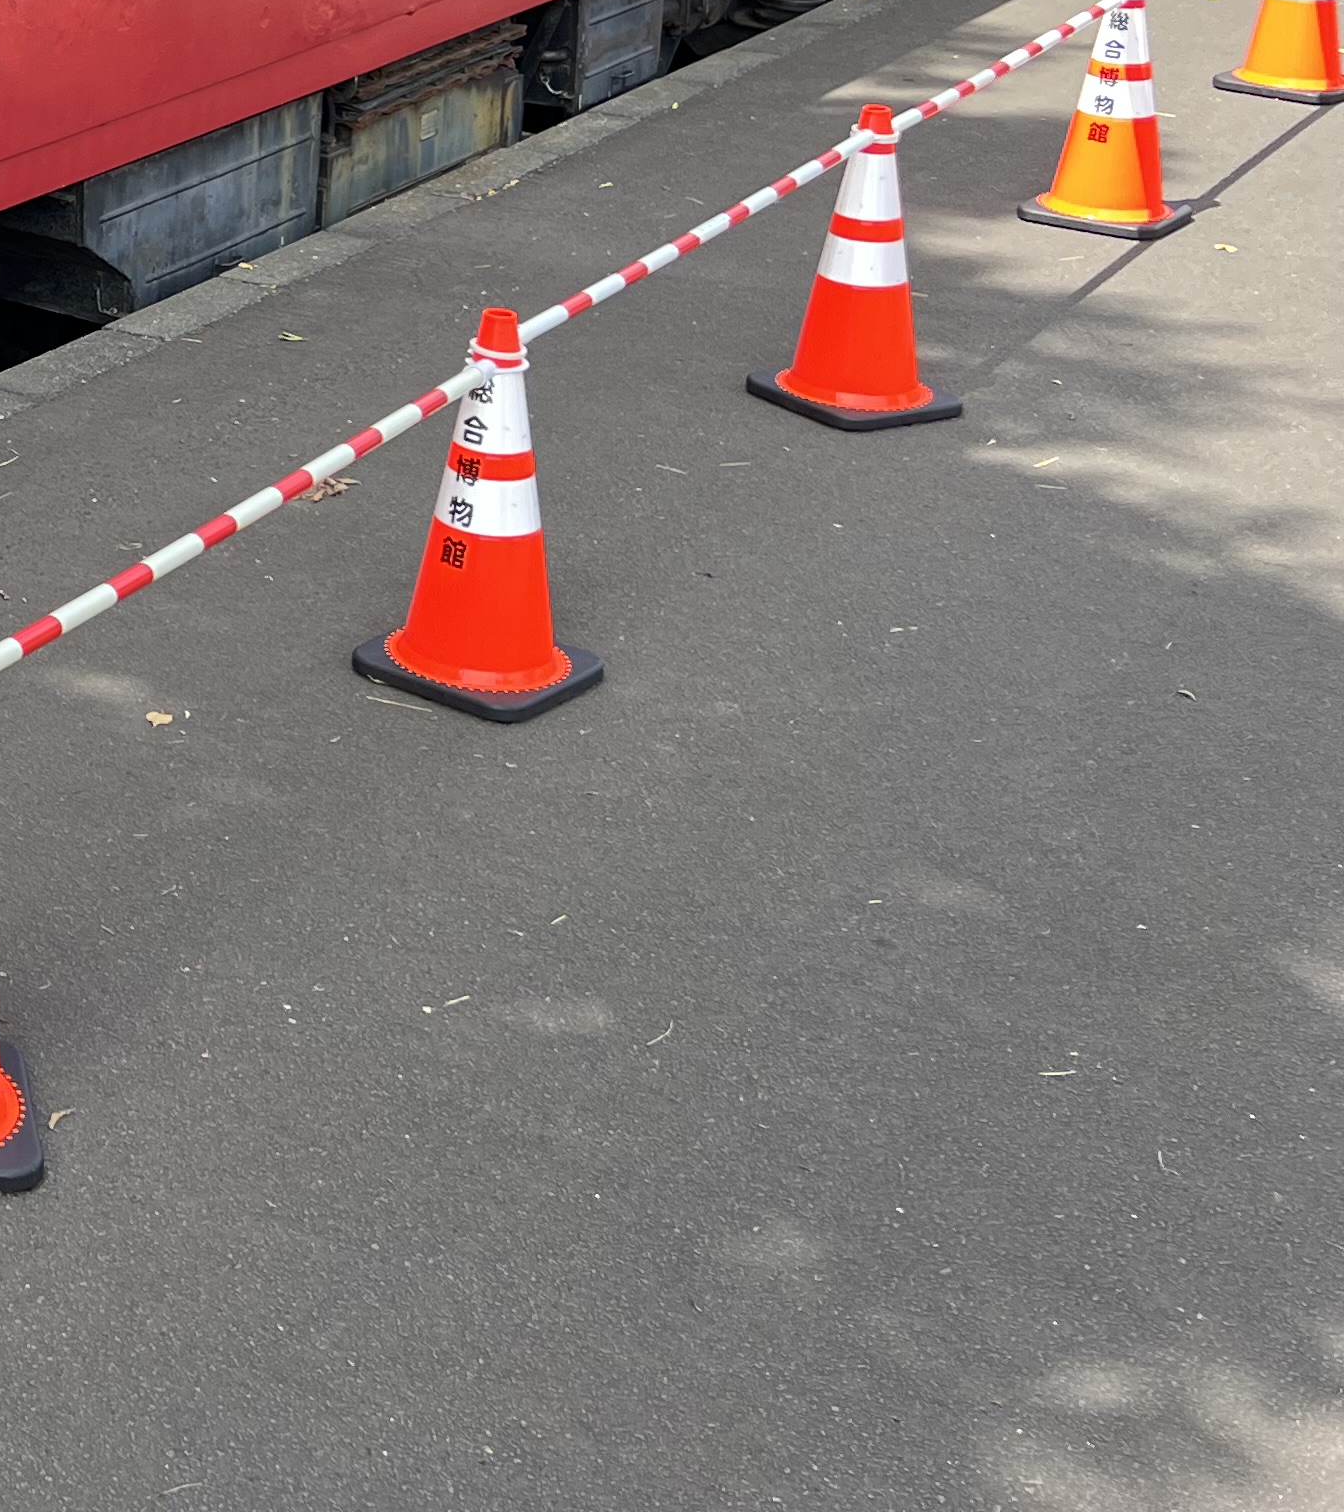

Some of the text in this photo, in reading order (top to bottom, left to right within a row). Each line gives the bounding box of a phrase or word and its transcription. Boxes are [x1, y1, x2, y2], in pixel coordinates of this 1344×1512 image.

[1088, 11, 1129, 144] 総合博物館
